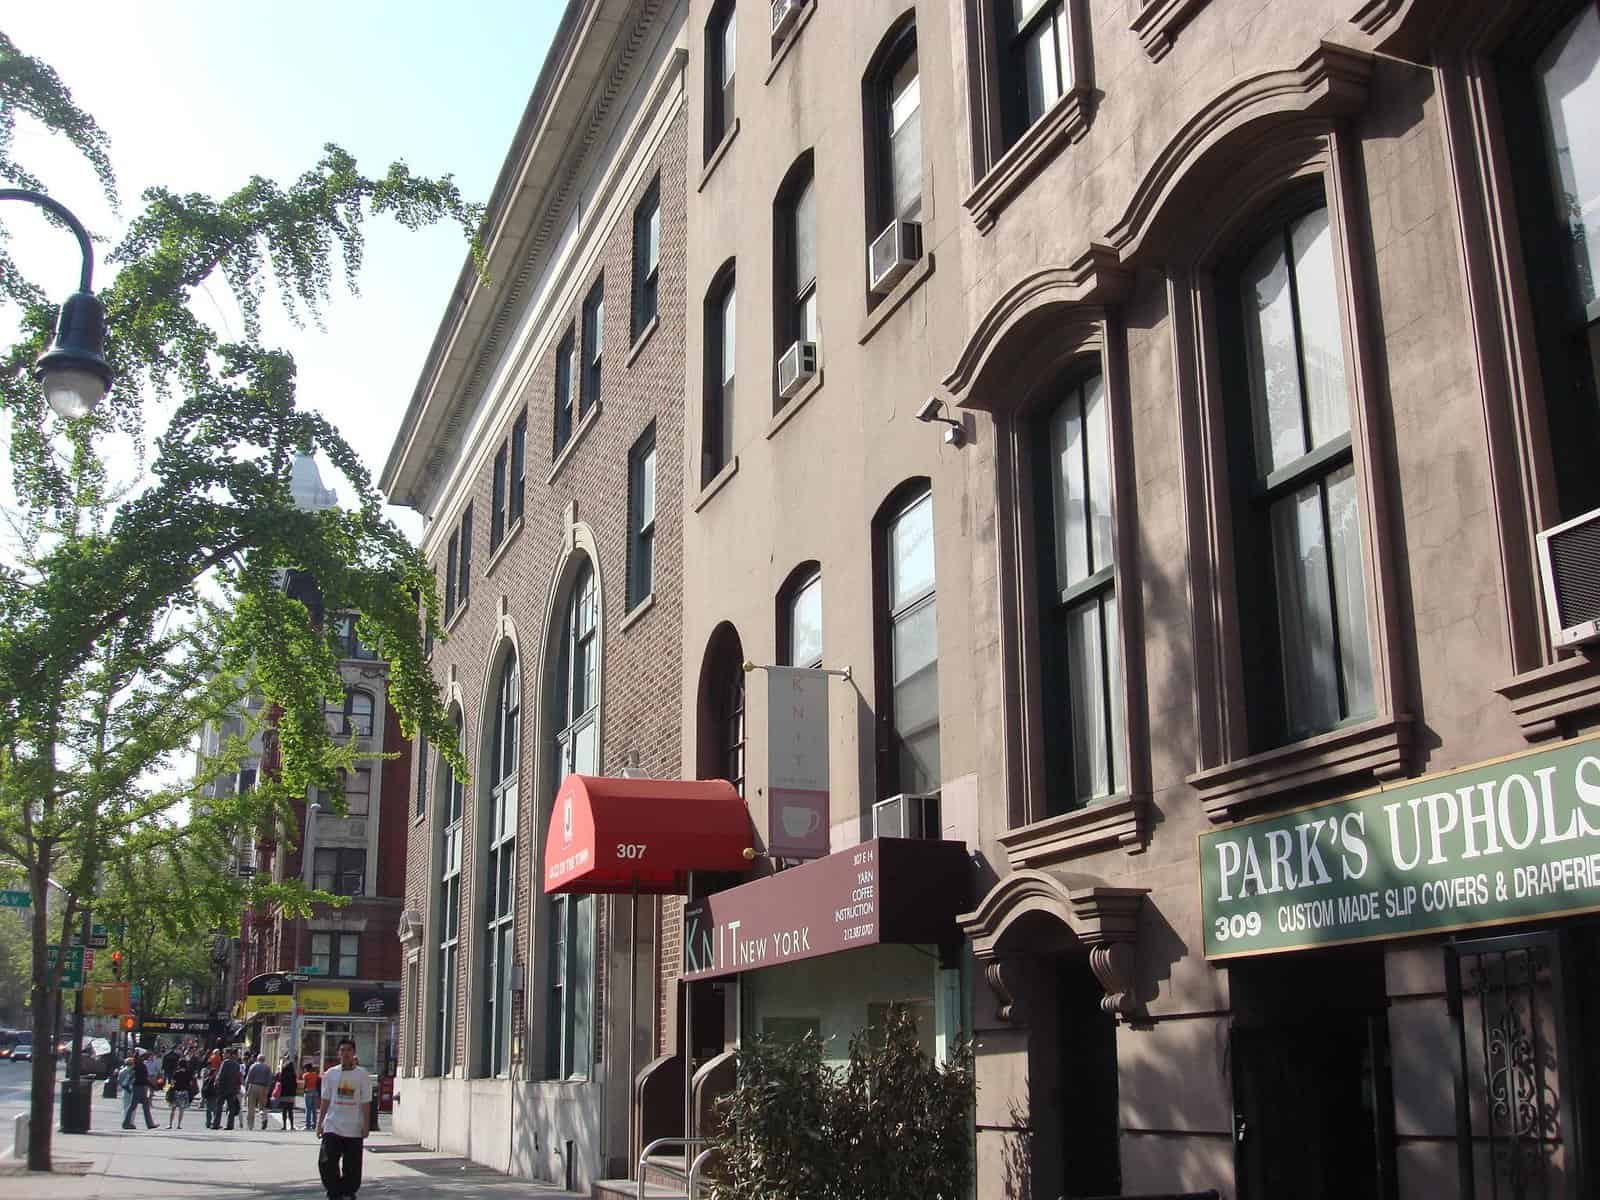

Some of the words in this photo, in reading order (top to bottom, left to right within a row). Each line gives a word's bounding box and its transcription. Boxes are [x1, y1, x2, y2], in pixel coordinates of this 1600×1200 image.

[1215, 810, 1368, 902] PARK'S
[1383, 755, 1600, 871] UPHOLS
[616, 843, 647, 859] 307
[857, 870, 873, 885] YARN
[852, 885, 873, 902] COFFEE
[1277, 899, 1335, 933] CUSTOM
[1338, 891, 1381, 923] MADE
[1385, 886, 1417, 918] SLIP
[1422, 873, 1489, 910] COVERS
[1495, 871, 1508, 902] &
[835, 901, 874, 922] INSTRUCTION
[1215, 910, 1262, 942] 309
[685, 918, 741, 976] KNIT
[740, 938, 768, 965] NEW
[773, 927, 811, 957] YORK
